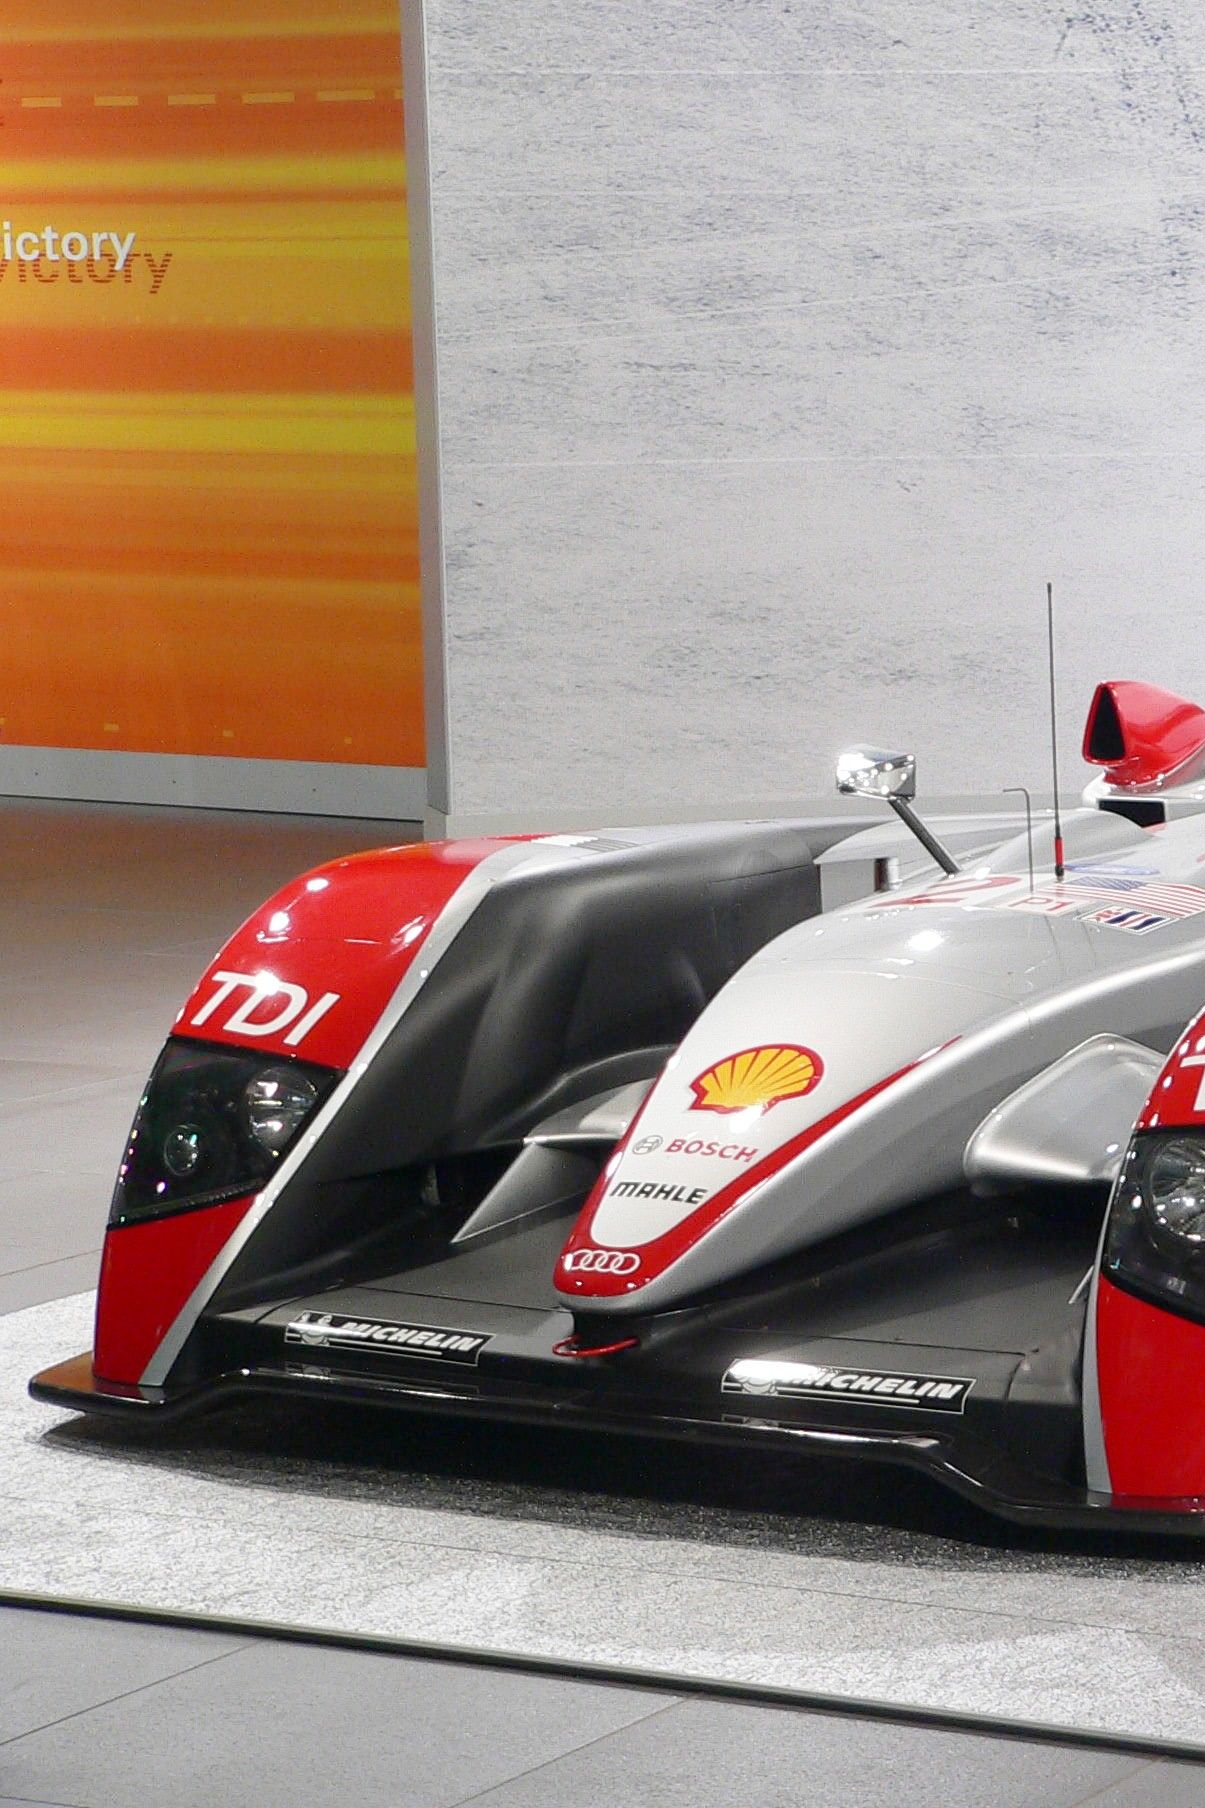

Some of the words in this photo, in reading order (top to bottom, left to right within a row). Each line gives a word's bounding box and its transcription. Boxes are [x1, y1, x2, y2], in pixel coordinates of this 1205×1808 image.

[190, 970, 341, 1046] TDI
[665, 1139, 758, 1163] BOSCH
[608, 1181, 708, 1205] MAHLE
[341, 1322, 483, 1351] MICHELIN
